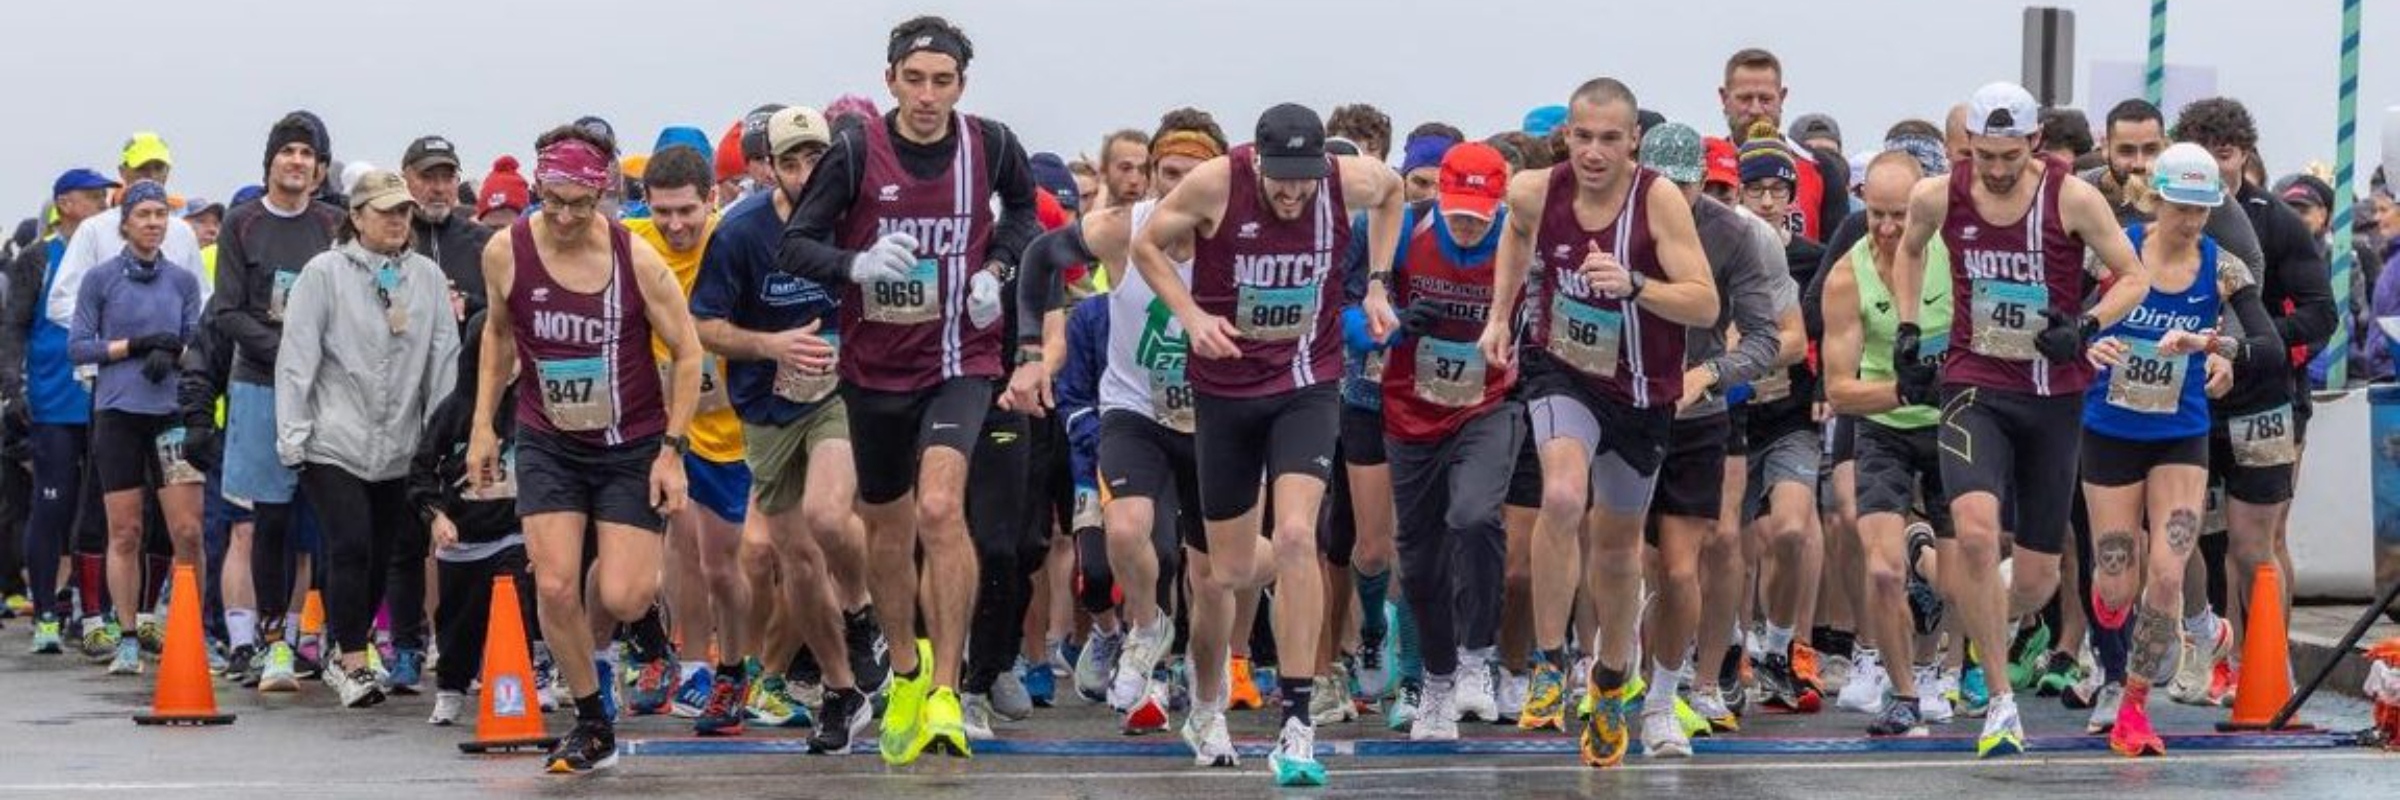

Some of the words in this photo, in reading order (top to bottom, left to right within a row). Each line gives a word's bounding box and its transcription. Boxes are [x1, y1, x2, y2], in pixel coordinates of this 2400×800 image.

[1233, 252, 1332, 287] NOTCH
[1964, 249, 2045, 281] NOTCH
[875, 280, 925, 308] 969
[533, 310, 622, 344] NOTCH
[1992, 302, 2027, 329] 45
[2127, 304, 2201, 331] Dirigo
[1567, 317, 1599, 346] 56
[1435, 356, 1466, 382] 37
[2125, 355, 2174, 385] 384
[545, 377, 593, 404] 347
[2241, 412, 2285, 442] 783
